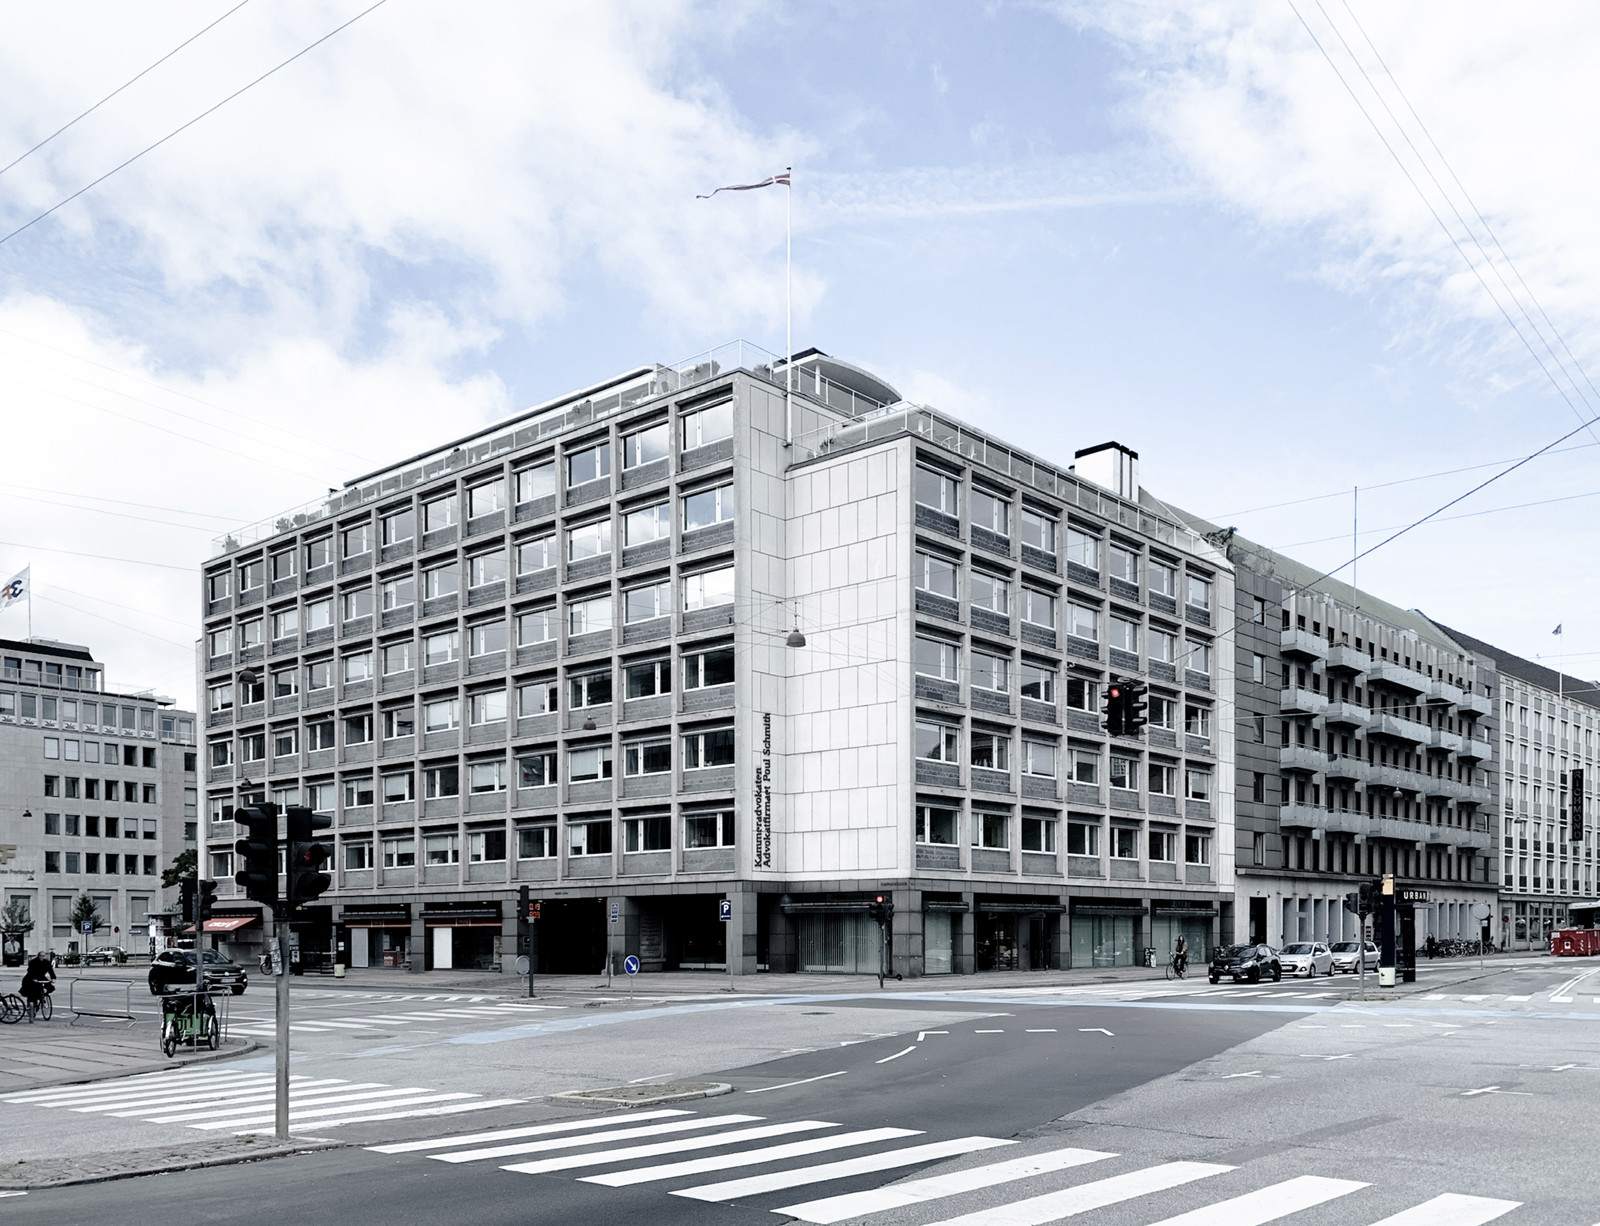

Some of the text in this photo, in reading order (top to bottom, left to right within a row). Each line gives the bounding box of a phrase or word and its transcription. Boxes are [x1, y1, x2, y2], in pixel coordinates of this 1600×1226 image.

[754, 767, 763, 868] Kammeradvokaten
[762, 713, 771, 868] Advokatfirmaet Poul Schmith
[1573, 771, 1582, 839] RICHMOND
